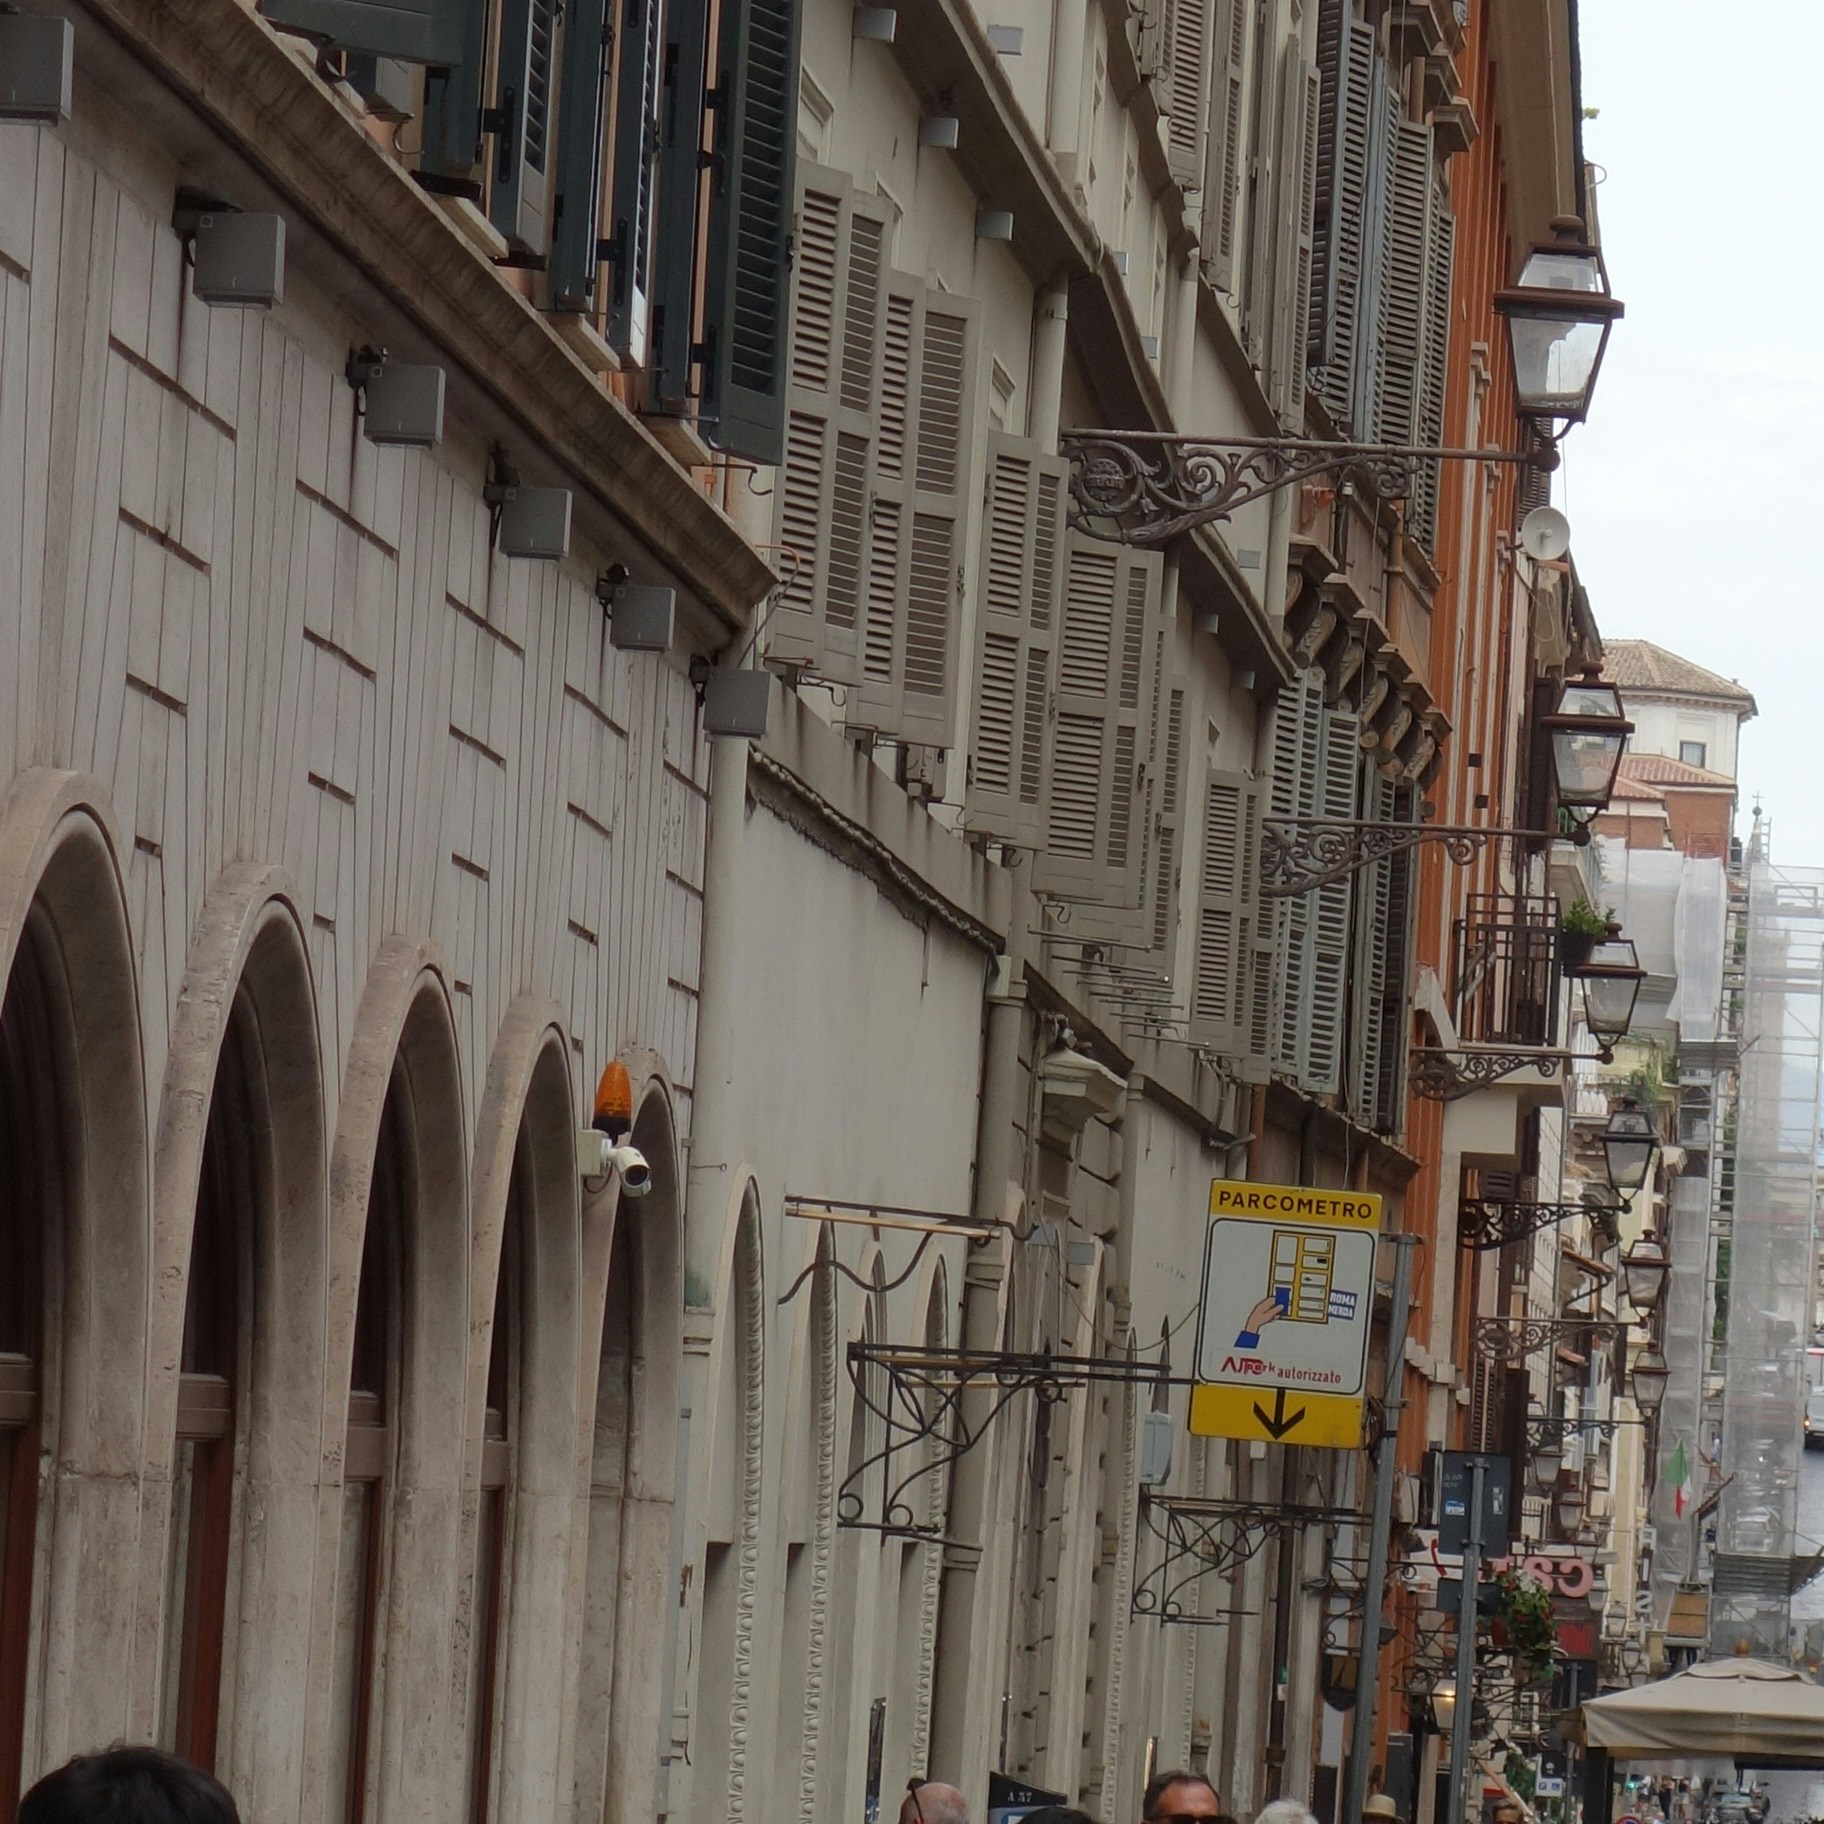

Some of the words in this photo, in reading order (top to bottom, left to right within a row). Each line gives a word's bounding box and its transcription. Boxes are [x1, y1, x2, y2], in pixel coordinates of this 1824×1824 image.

[1219, 1190, 1372, 1219] PARCOMETRO
[1329, 1292, 1355, 1307] ROMA
[1277, 1367, 1342, 1384] autorizzato
